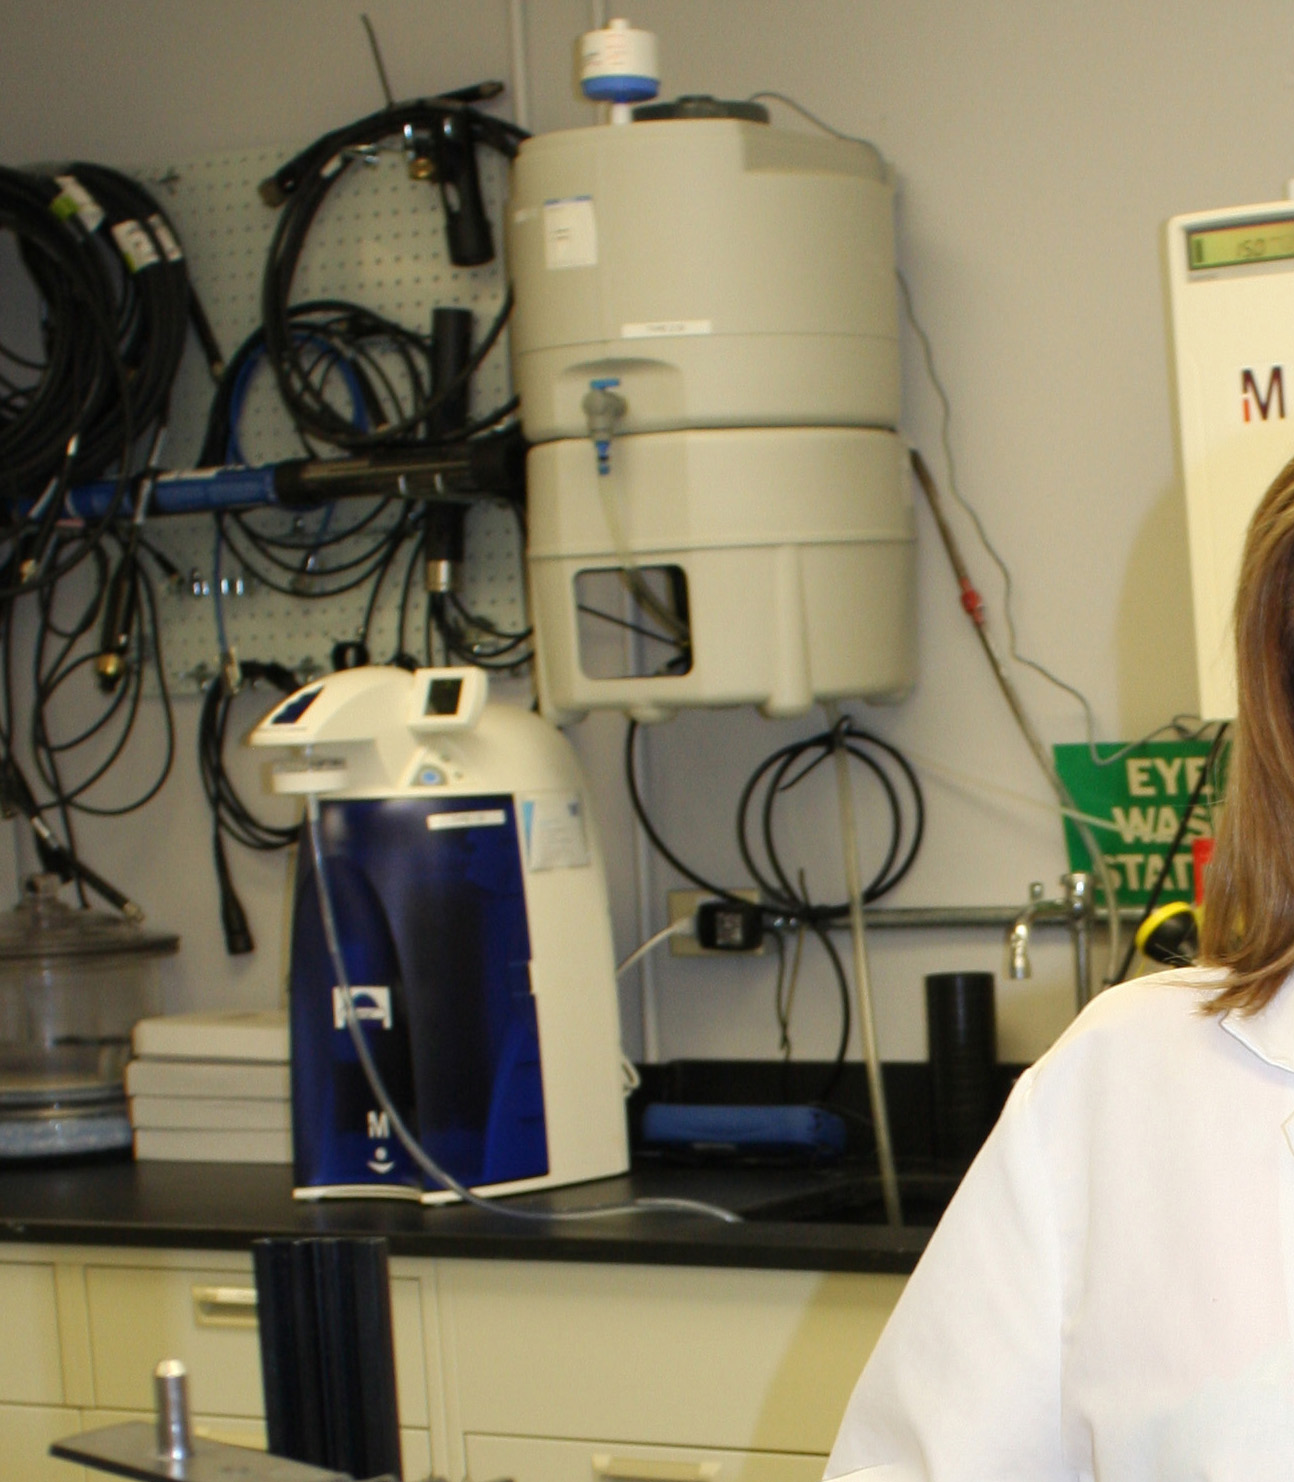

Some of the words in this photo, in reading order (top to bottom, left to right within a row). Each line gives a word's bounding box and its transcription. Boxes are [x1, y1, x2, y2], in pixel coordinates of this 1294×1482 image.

[1125, 757, 1214, 797] EYE
[1112, 805, 1219, 844] WAS
[1096, 853, 1194, 891] STAT
[367, 1110, 391, 1139] M
